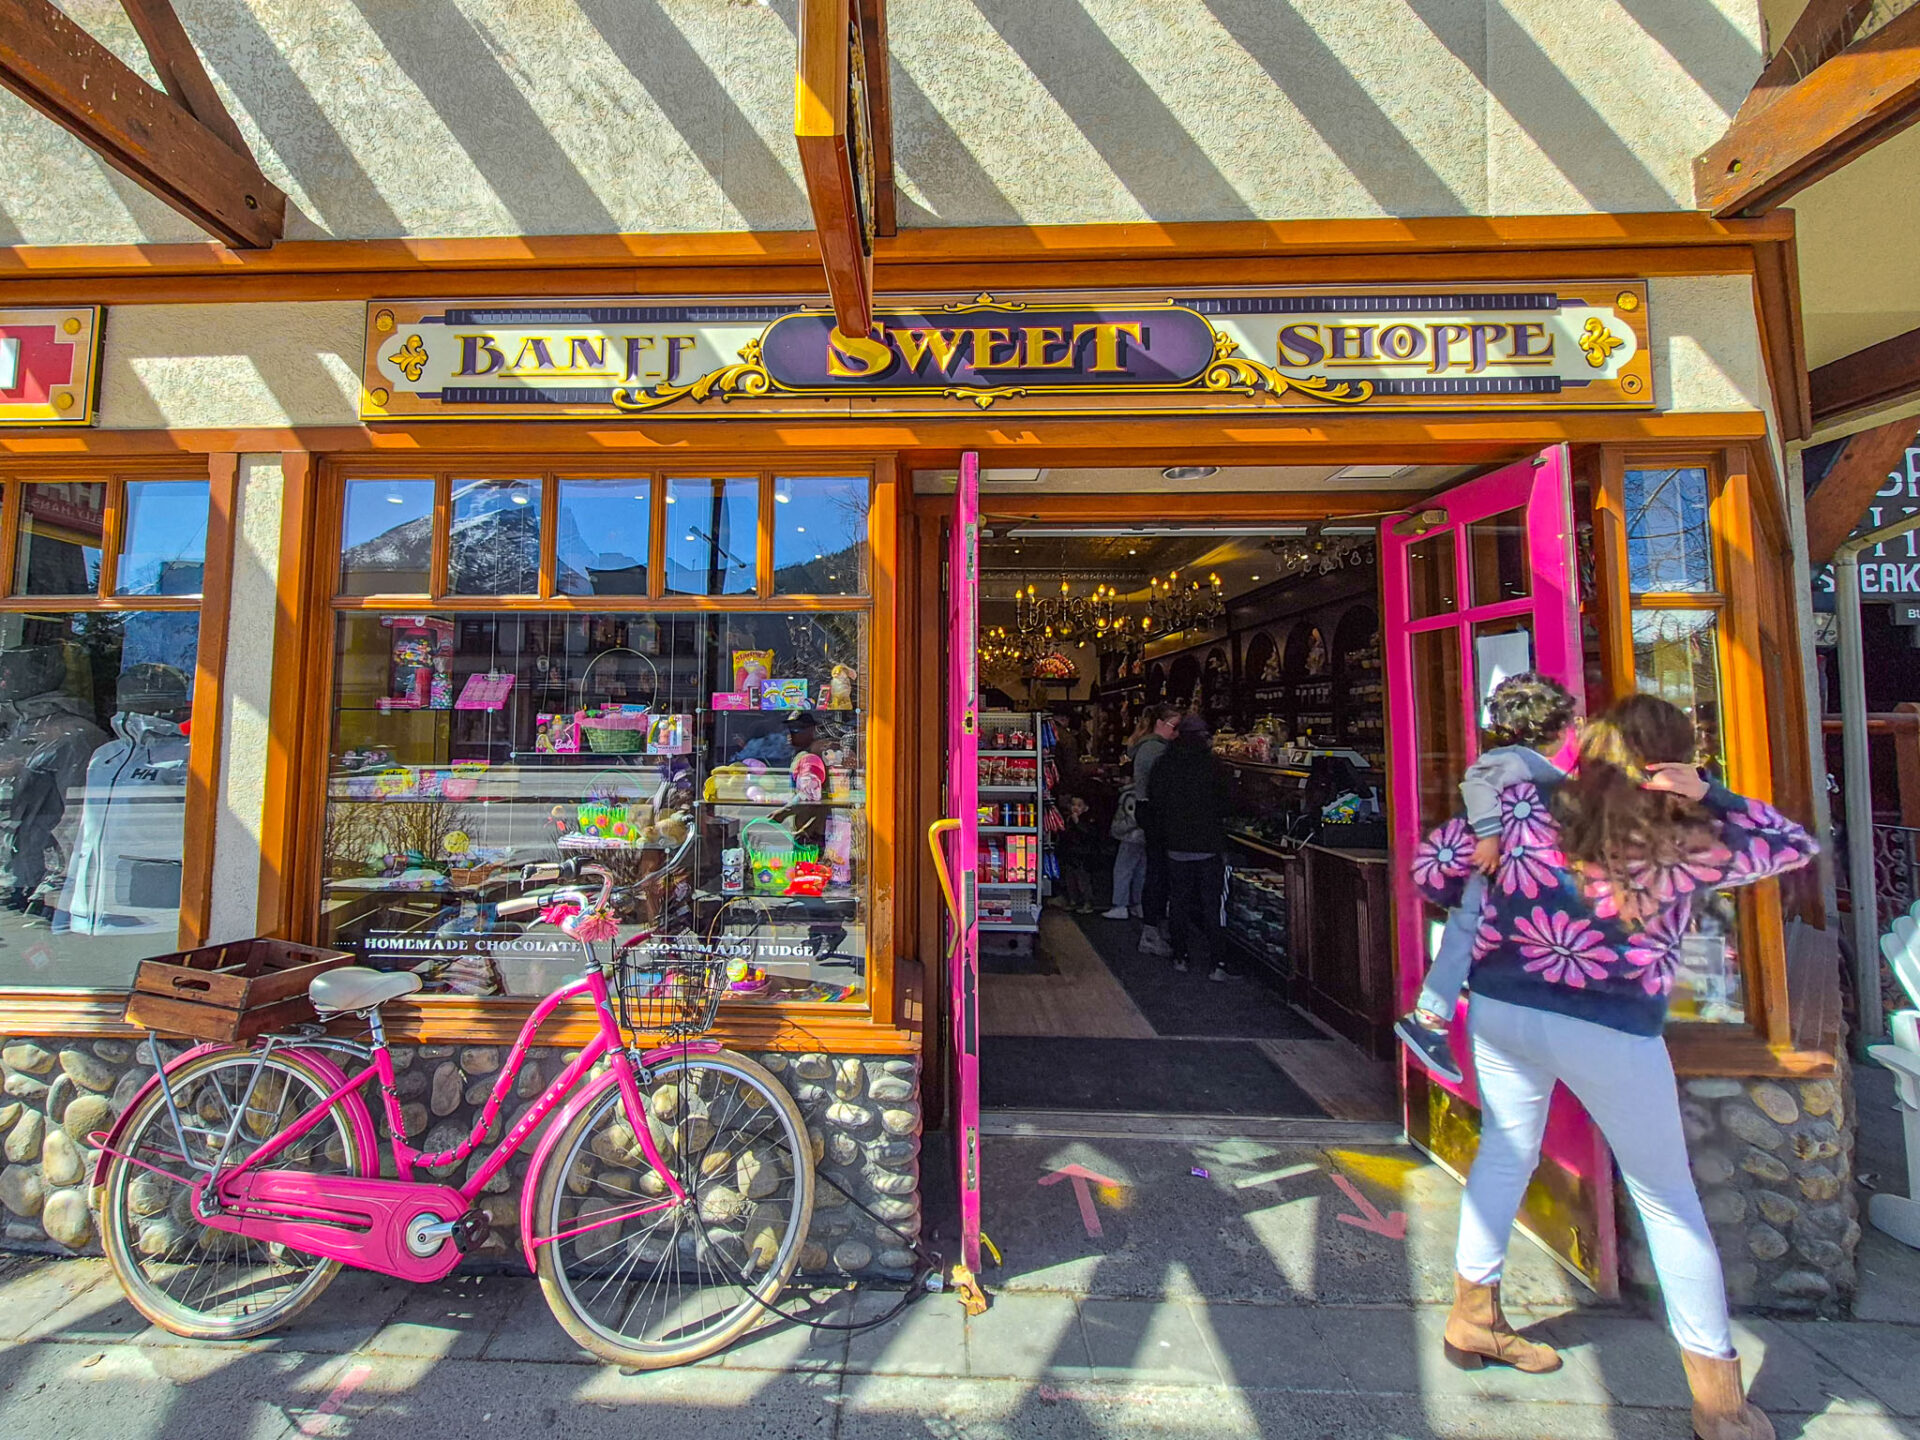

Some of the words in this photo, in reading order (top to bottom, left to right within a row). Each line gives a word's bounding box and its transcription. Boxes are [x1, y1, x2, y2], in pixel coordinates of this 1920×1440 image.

[451, 333, 697, 383] BANFF
[826, 321, 1145, 377] SWEET
[1277, 322, 1556, 375] SHOPPE
[1818, 562, 1920, 593] SEAK
[130, 767, 159, 781] HH
[364, 937, 469, 950] HOMEMADE
[474, 939, 582, 952] CHOCOLATE
[646, 943, 752, 957] HOMEMADE
[758, 945, 815, 957] FUDGE
[500, 1082, 564, 1154] ELECTRA
